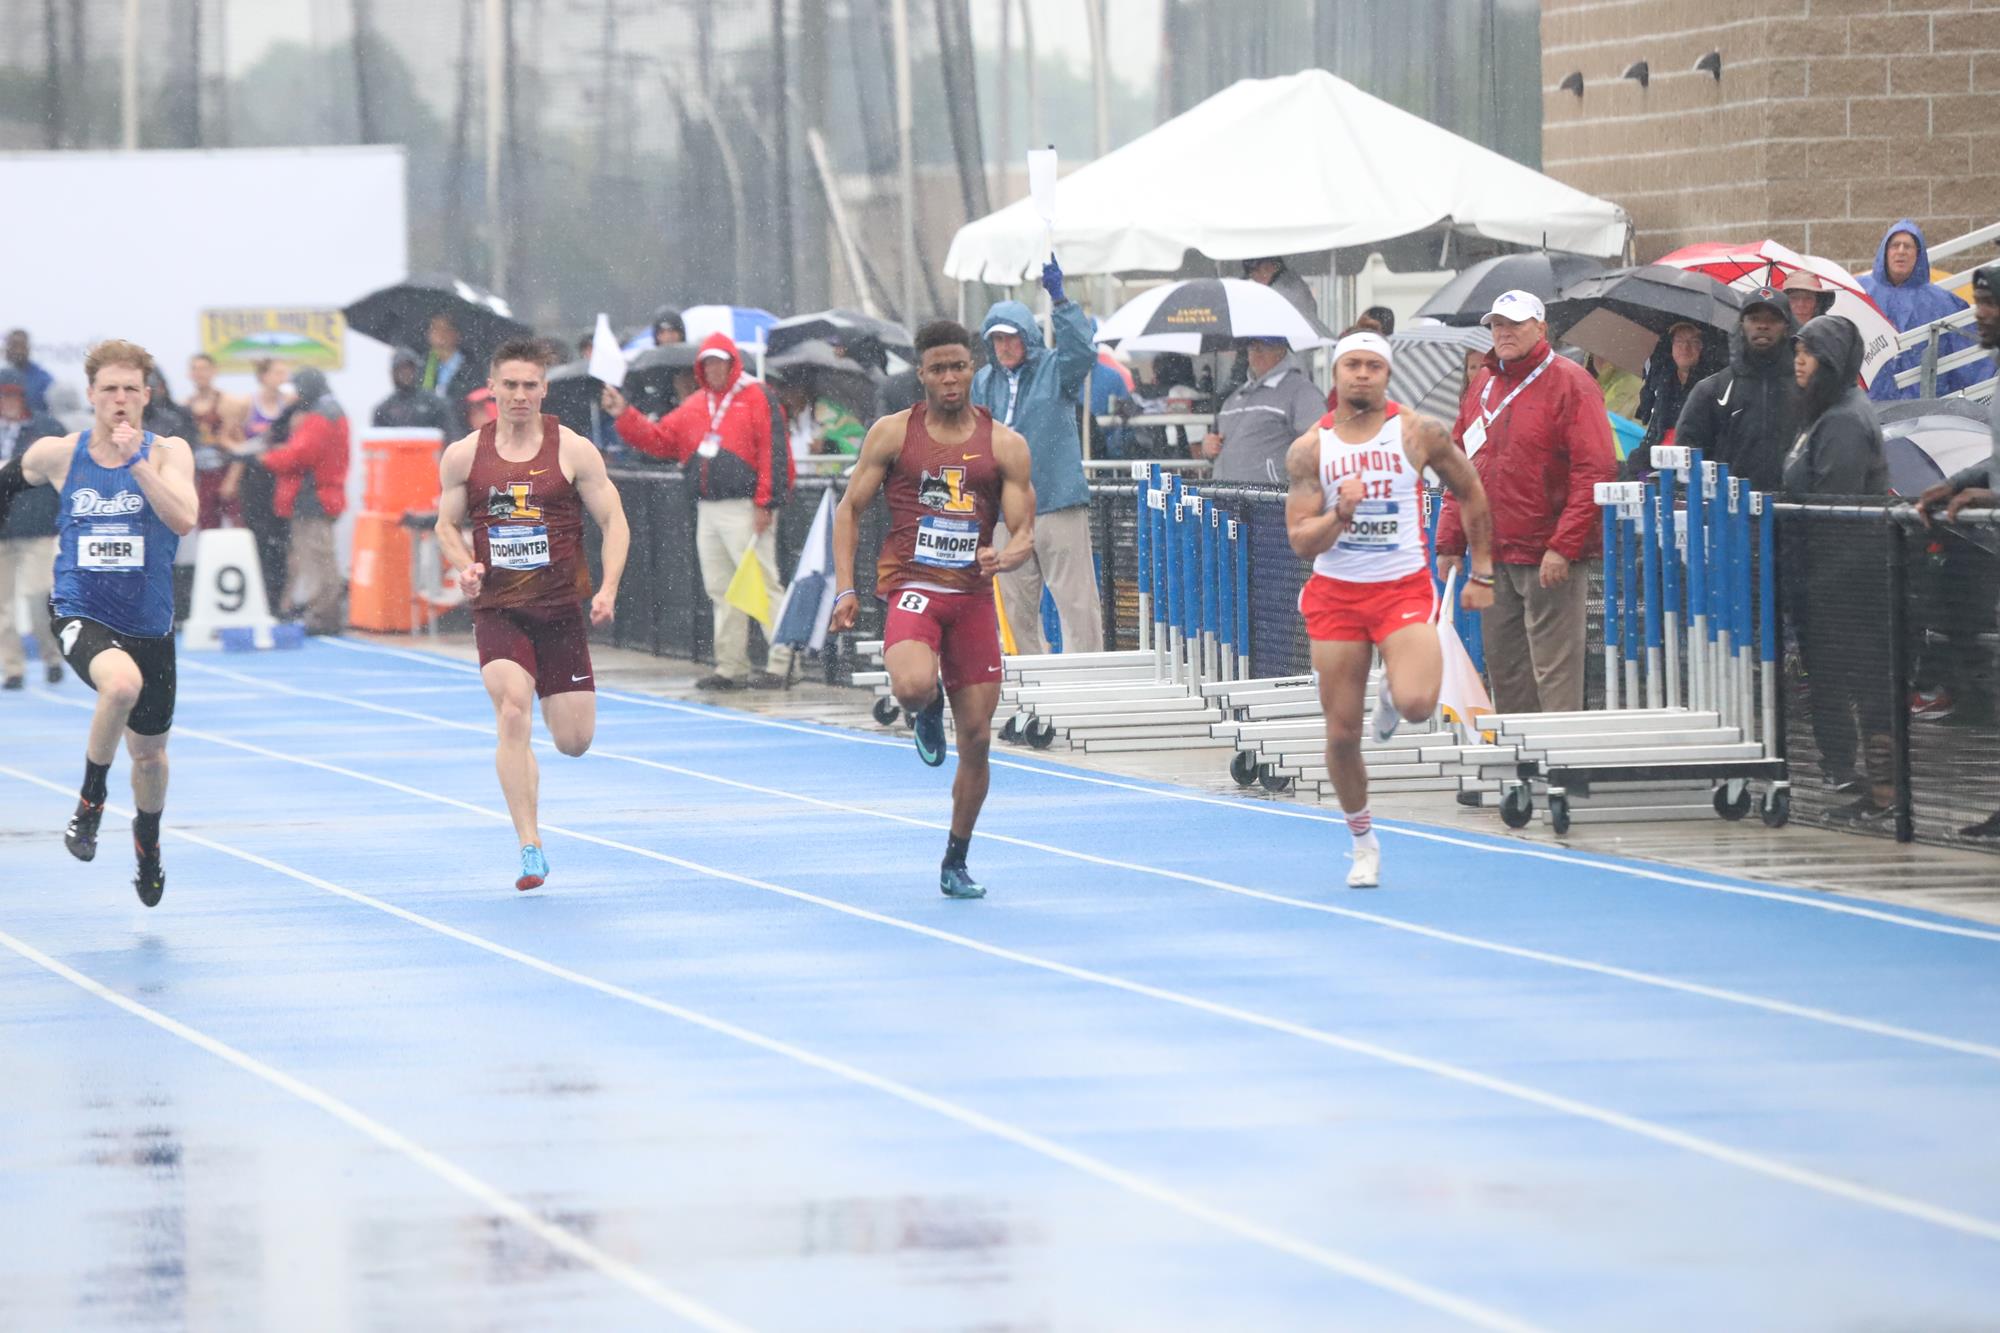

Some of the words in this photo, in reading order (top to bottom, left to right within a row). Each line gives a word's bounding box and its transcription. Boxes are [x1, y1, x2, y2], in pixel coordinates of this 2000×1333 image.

[1325, 451, 1403, 485] ILLINOIS
[71, 488, 143, 516] Drake
[88, 542, 132, 557] CHIER
[491, 541, 547, 557] TODHUNTER
[918, 532, 976, 552] ELMORE
[217, 565, 246, 612] 9
[902, 594, 922, 610] 8
